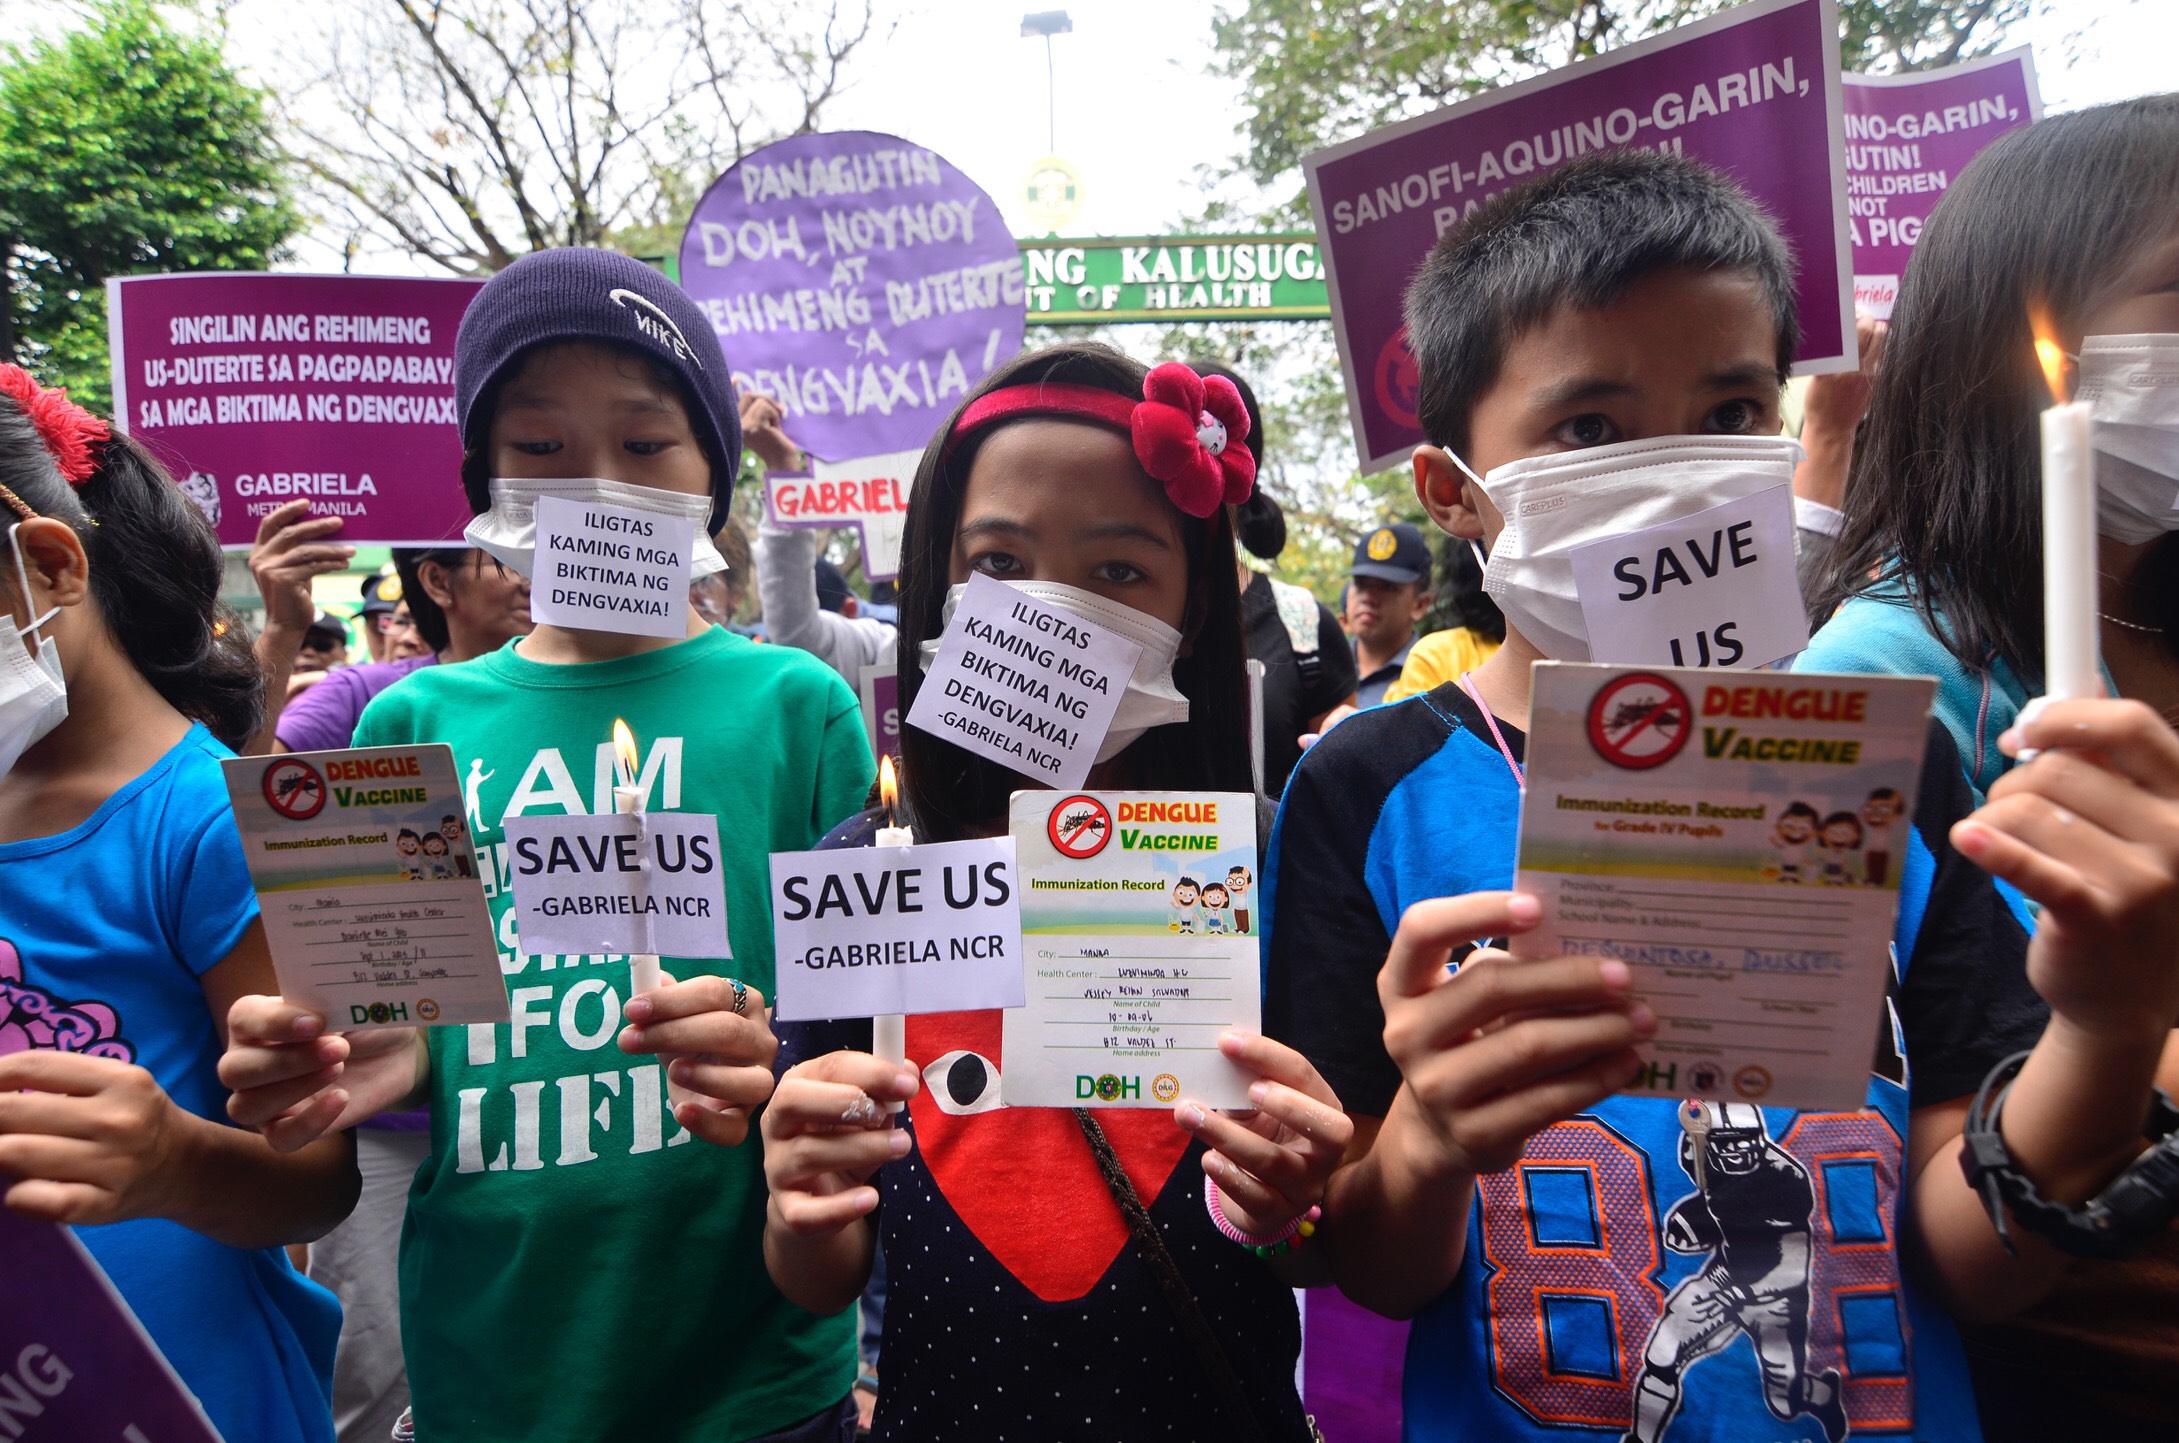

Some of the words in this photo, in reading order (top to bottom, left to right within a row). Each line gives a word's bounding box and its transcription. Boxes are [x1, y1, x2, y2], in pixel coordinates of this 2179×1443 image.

[1333, 56, 1811, 235] SANOFI-AQUINO-GARIN,
[740, 149, 942, 205] PANAGUTIN
[700, 216, 821, 268] DOH,
[822, 196, 980, 256] NOYNOY
[830, 256, 868, 288] AT
[1026, 247, 1087, 286] NG
[885, 257, 1026, 327] DUTERTE
[1076, 284, 1121, 311] OF
[1145, 282, 1272, 310] HEALTH
[170, 315, 257, 346] SINGILIN
[260, 315, 311, 343] ANG
[314, 316, 431, 344] REHIMENG
[634, 310, 687, 361] NIKE
[845, 328, 890, 360] SA
[143, 354, 264, 388] US-DUTERTE
[268, 355, 295, 382] SA
[140, 399, 164, 429] SA
[167, 397, 213, 427] MGA
[216, 394, 303, 425] BIKTIMA
[306, 396, 342, 423] NG
[235, 472, 378, 497] GABRIELA
[775, 478, 909, 517] GABRIEL
[1521, 497, 1565, 514] CAREPLUS
[584, 511, 654, 537] ILIGTAS
[549, 533, 630, 560] KAMING
[636, 546, 680, 568] MGA
[1613, 520, 1758, 602] SAVE
[556, 562, 637, 587] BIKTIMA
[642, 573, 670, 592] NG
[551, 588, 669, 618] DENGVAXIA!
[1011, 601, 1092, 650] ILIGTAS
[964, 616, 1055, 669] KAMING
[1057, 658, 1109, 696] MGA
[1669, 621, 1744, 668] US
[960, 650, 1049, 704] BIKTIMA
[1054, 692, 1089, 720] NG
[943, 678, 1080, 751] DENGVAXIA!
[1703, 685, 1869, 723] DENGUE
[937, 710, 1023, 757] -GABRIELA
[1026, 747, 1062, 774] NCR
[326, 756, 421, 782] DENGUE
[1117, 801, 1218, 824] DENGUE
[1557, 793, 1692, 817] Immunization
[1696, 800, 1767, 820] Record
[264, 836, 347, 851] Immunization
[348, 832, 388, 846] Record
[1613, 819, 1658, 834] Grade
[1678, 822, 1724, 839] Pupils
[516, 834, 641, 875] SAVE
[656, 834, 714, 875] US
[782, 868, 924, 921] SAVE
[943, 861, 1011, 910] US
[1031, 877, 1121, 891] Immunization
[1122, 878, 1165, 891] Record
[532, 895, 660, 917] -GABRIELA
[665, 895, 711, 918] NCR
[794, 939, 941, 970] -GABRIELA
[950, 934, 1005, 961] NCR
[1037, 949, 1057, 960] City:
[1037, 969, 1064, 979] Health
[1066, 970, 1093, 979] Center
[350, 1001, 409, 1025] DOH
[1113, 1000, 1134, 1008] Name
[1134, 1000, 1142, 1008] of
[1142, 1000, 1161, 1008] Child
[1112, 1025, 1141, 1034] Birthday
[1146, 1025, 1160, 1034] Age
[1112, 1049, 1133, 1057] Home
[1134, 1049, 1161, 1057] address
[1076, 1074, 1141, 1102] DOH
